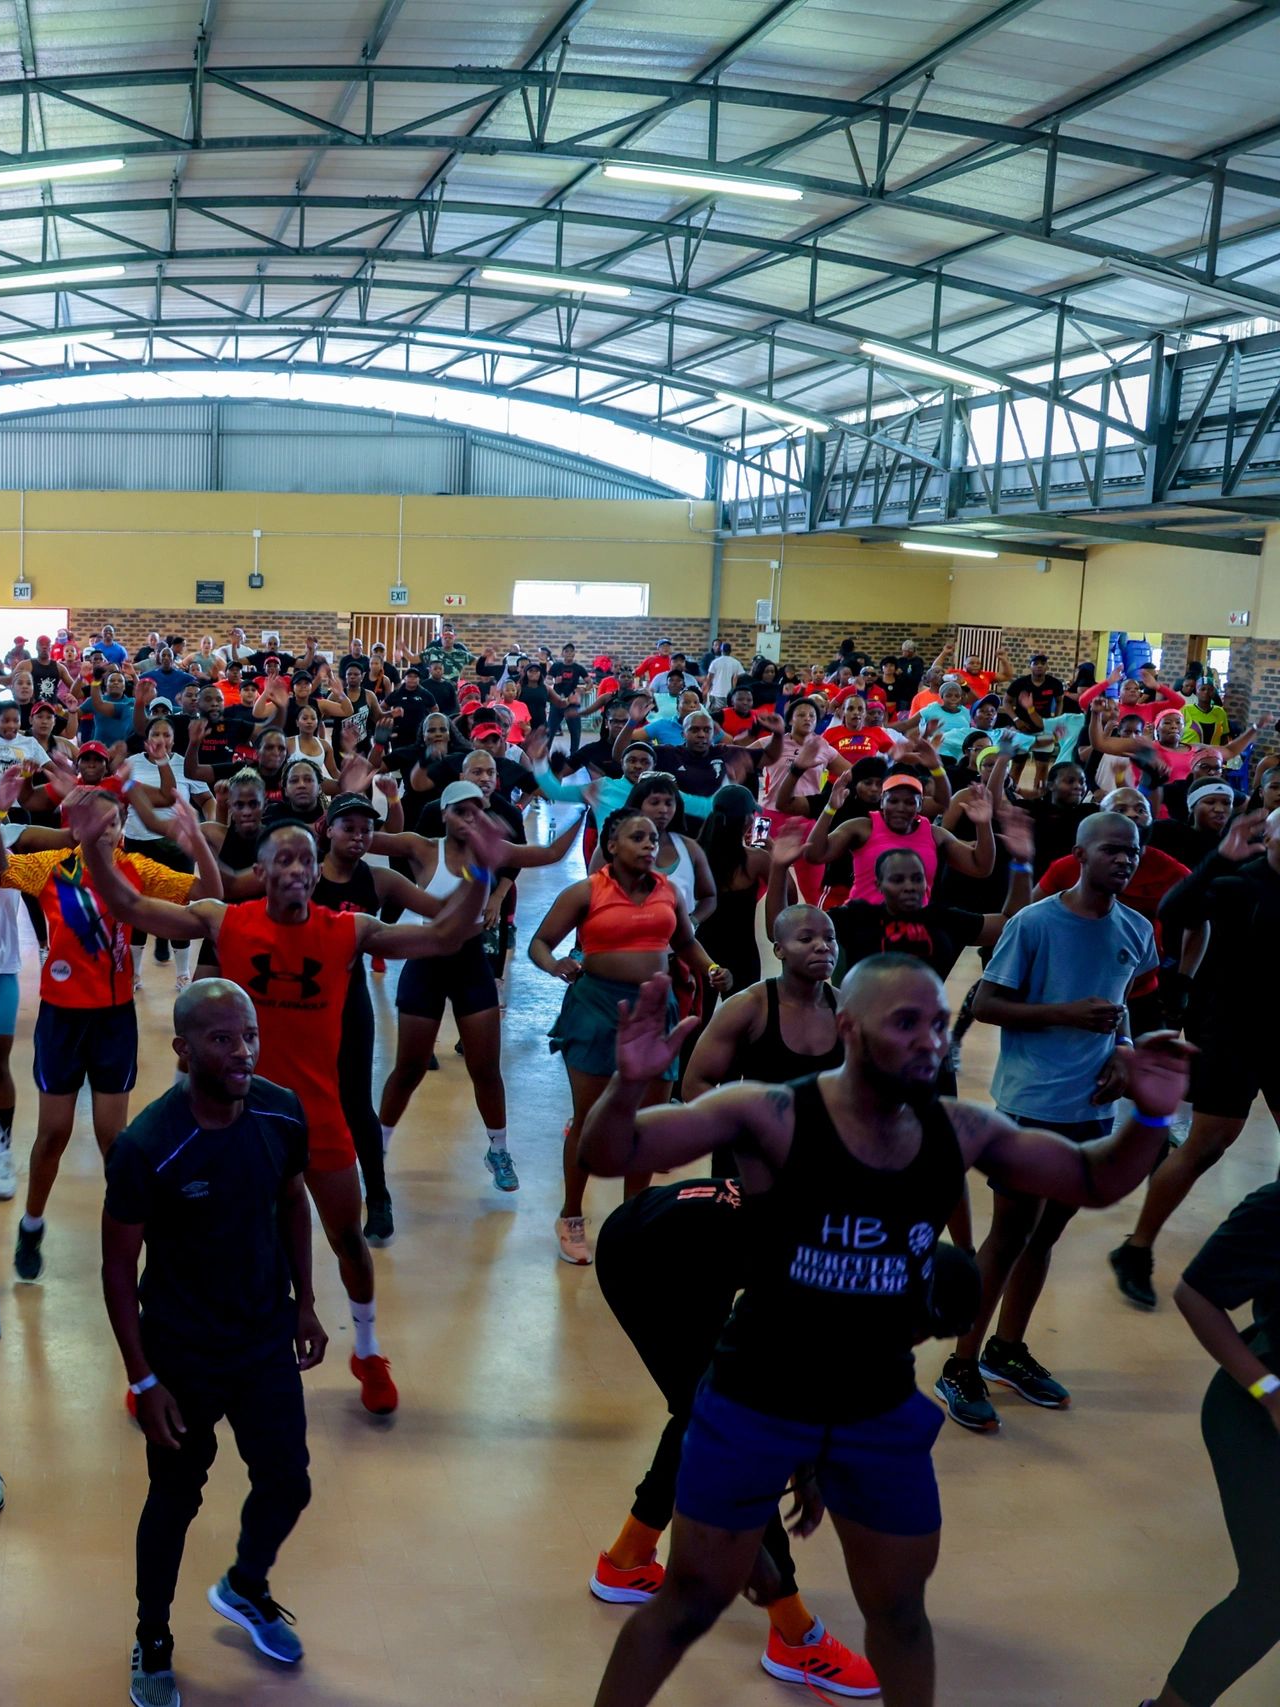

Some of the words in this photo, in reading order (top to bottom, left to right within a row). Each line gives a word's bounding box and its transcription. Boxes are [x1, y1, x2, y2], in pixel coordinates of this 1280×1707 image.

[14, 587, 30, 597] EXIT
[391, 591, 407, 601] EXIT
[821, 1213, 888, 1250] HB
[796, 1246, 907, 1276] HERCULES
[789, 1261, 908, 1293] BOOTCAMP
